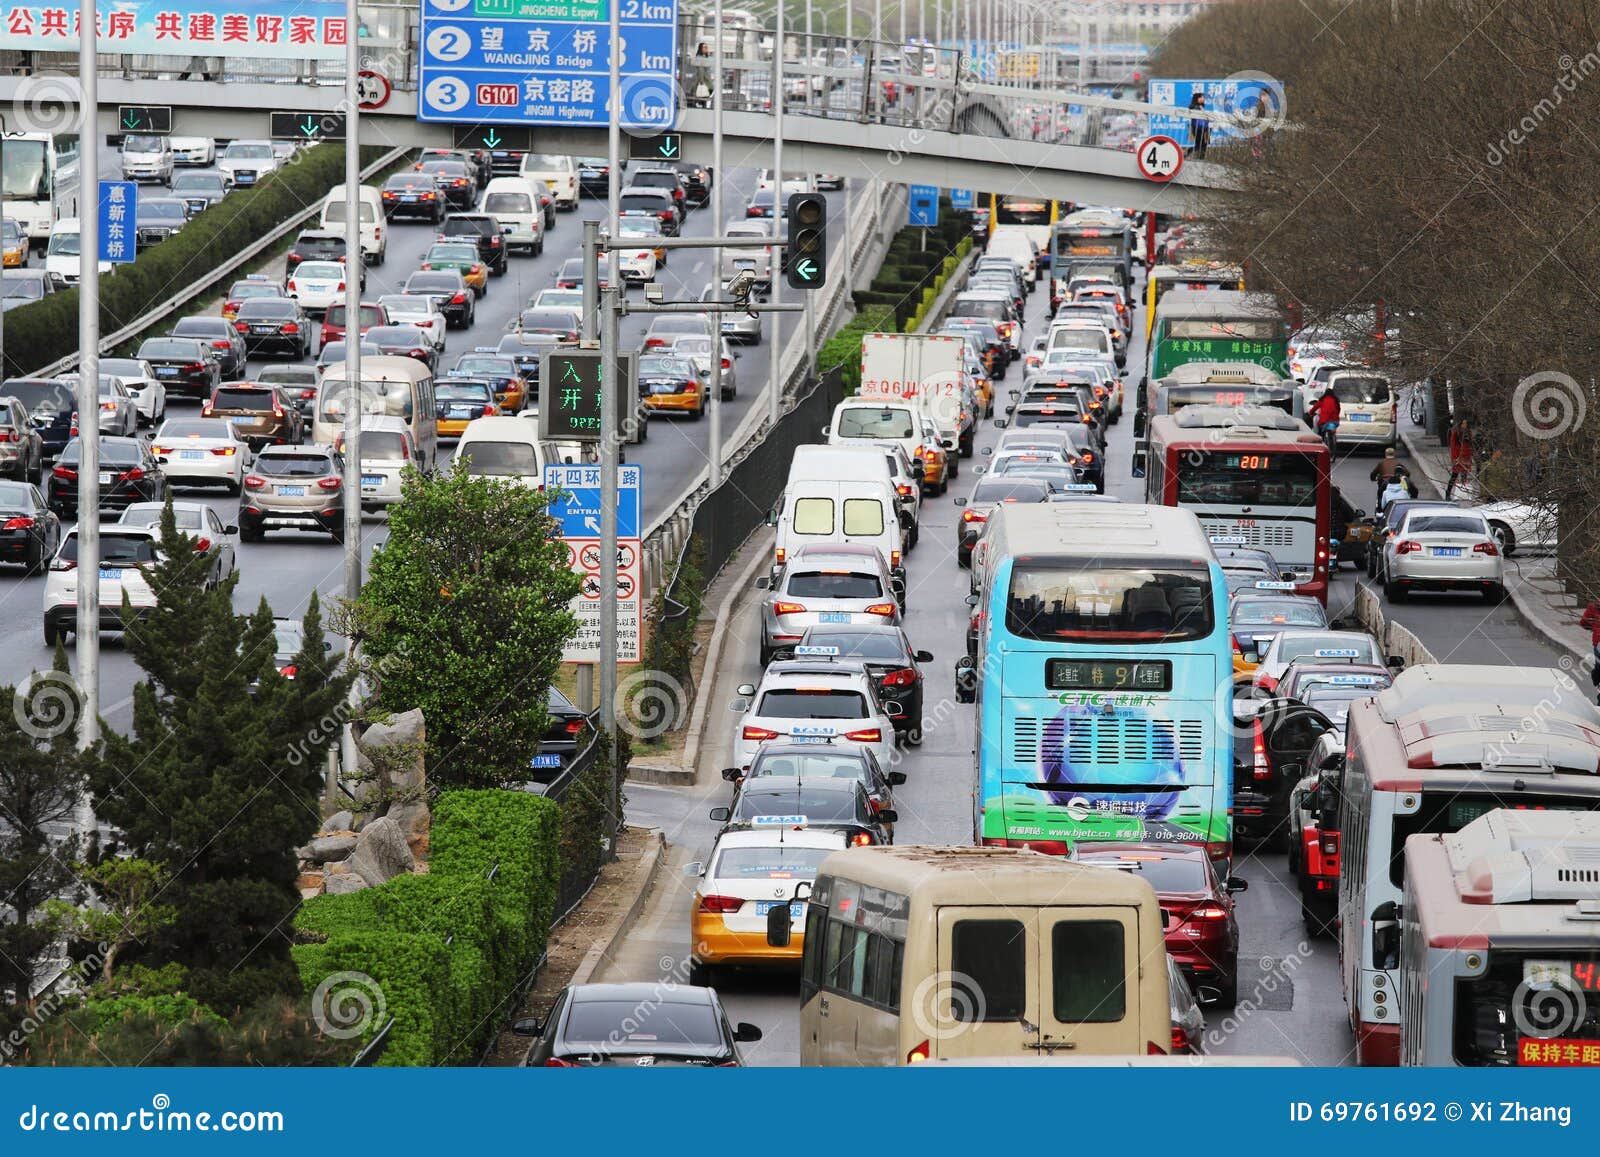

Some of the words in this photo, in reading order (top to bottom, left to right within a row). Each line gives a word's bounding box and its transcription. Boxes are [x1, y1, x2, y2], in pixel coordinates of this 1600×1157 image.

[518, 5, 568, 17] JINGCHENG
[572, 7, 599, 20] Expwy
[642, 1, 672, 20] km
[8, 8, 136, 39] 公共序
[155, 12, 347, 45] 共建美好家园
[439, 33, 458, 55] 2
[480, 27, 597, 54] 望京桥
[641, 51, 671, 70] km
[484, 53, 550, 66] WANGJING
[556, 57, 593, 69] Bridge
[438, 83, 457, 106] 3
[479, 86, 518, 105] G101
[524, 78, 595, 104] 京密路
[640, 101, 669, 120] km
[524, 104, 555, 118] JINGMI
[559, 106, 594, 120] Highway
[107, 186, 126, 258] 惠新东桥
[1240, 455, 1269, 469] 201
[548, 469, 638, 486] 北四环路
[567, 508, 601, 516] ENTRA
[1115, 666, 1128, 685] 9
[1095, 800, 1147, 814] 速通科技
[1048, 828, 1111, 838] www.bjetc.cn
[1522, 1042, 1600, 1064] 保持车距
